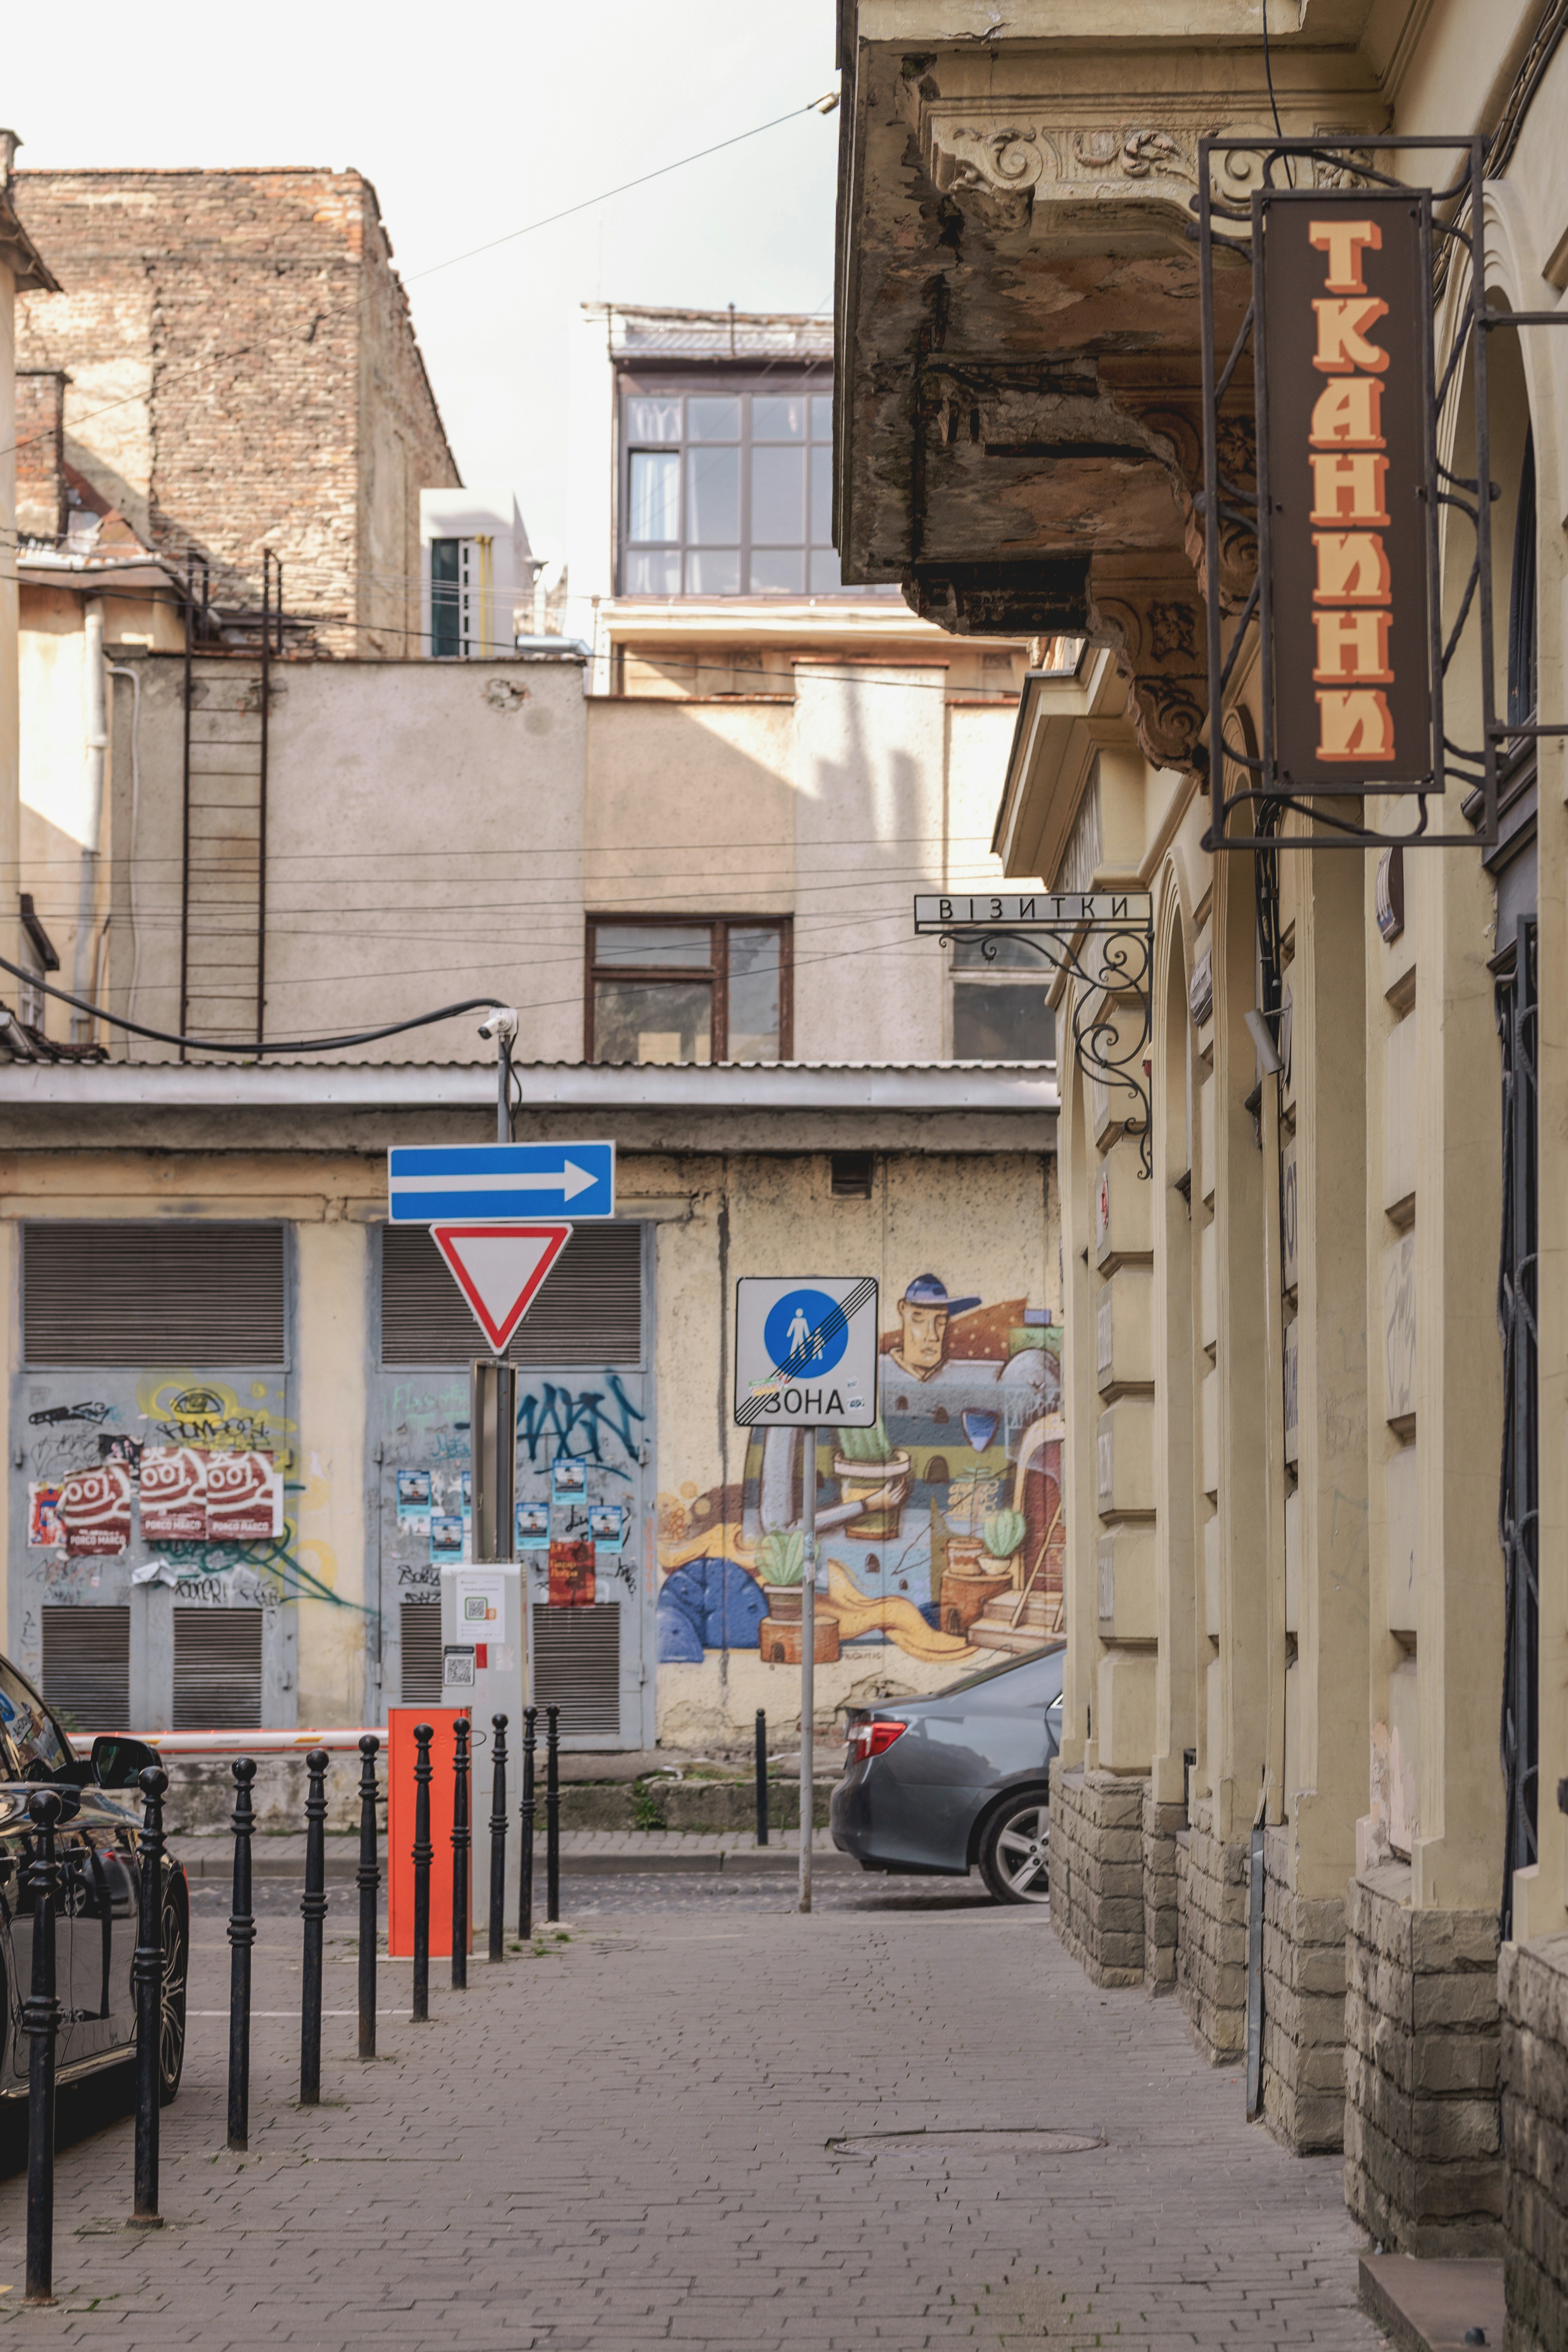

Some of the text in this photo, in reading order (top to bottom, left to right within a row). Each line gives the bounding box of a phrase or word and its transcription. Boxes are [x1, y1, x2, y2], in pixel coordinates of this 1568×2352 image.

[1308, 220, 1395, 762] ТКАНИНИ
[939, 897, 1128, 920] ВІЗИТКИ
[764, 1388, 844, 1415] ЗОНА
